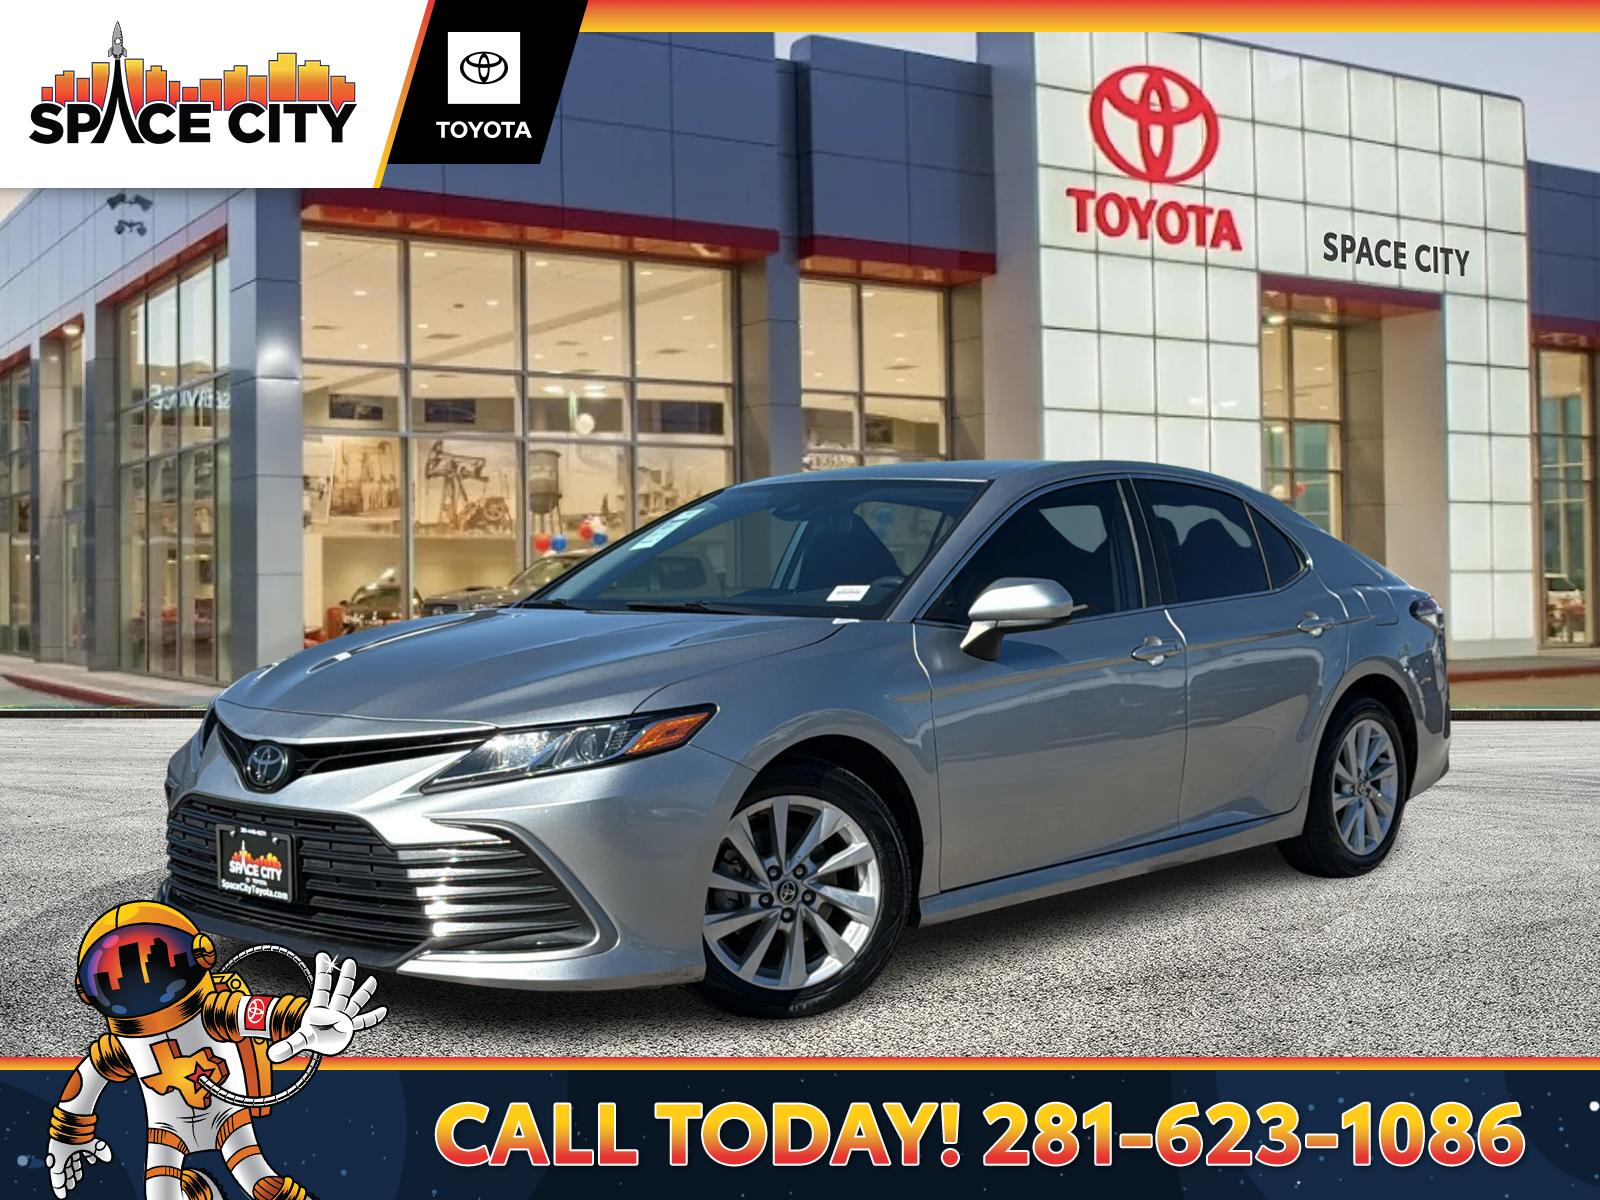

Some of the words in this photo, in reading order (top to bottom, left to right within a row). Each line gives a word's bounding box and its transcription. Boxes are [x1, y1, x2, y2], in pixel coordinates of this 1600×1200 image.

[1066, 188, 1242, 251] TOYOTA
[1323, 231, 1407, 270] SPACE
[1414, 244, 1470, 276] CITY
[229, 860, 260, 877] SPACE
[260, 866, 283, 881] CITY
[221, 879, 289, 900] SpaceCityToyota.com
